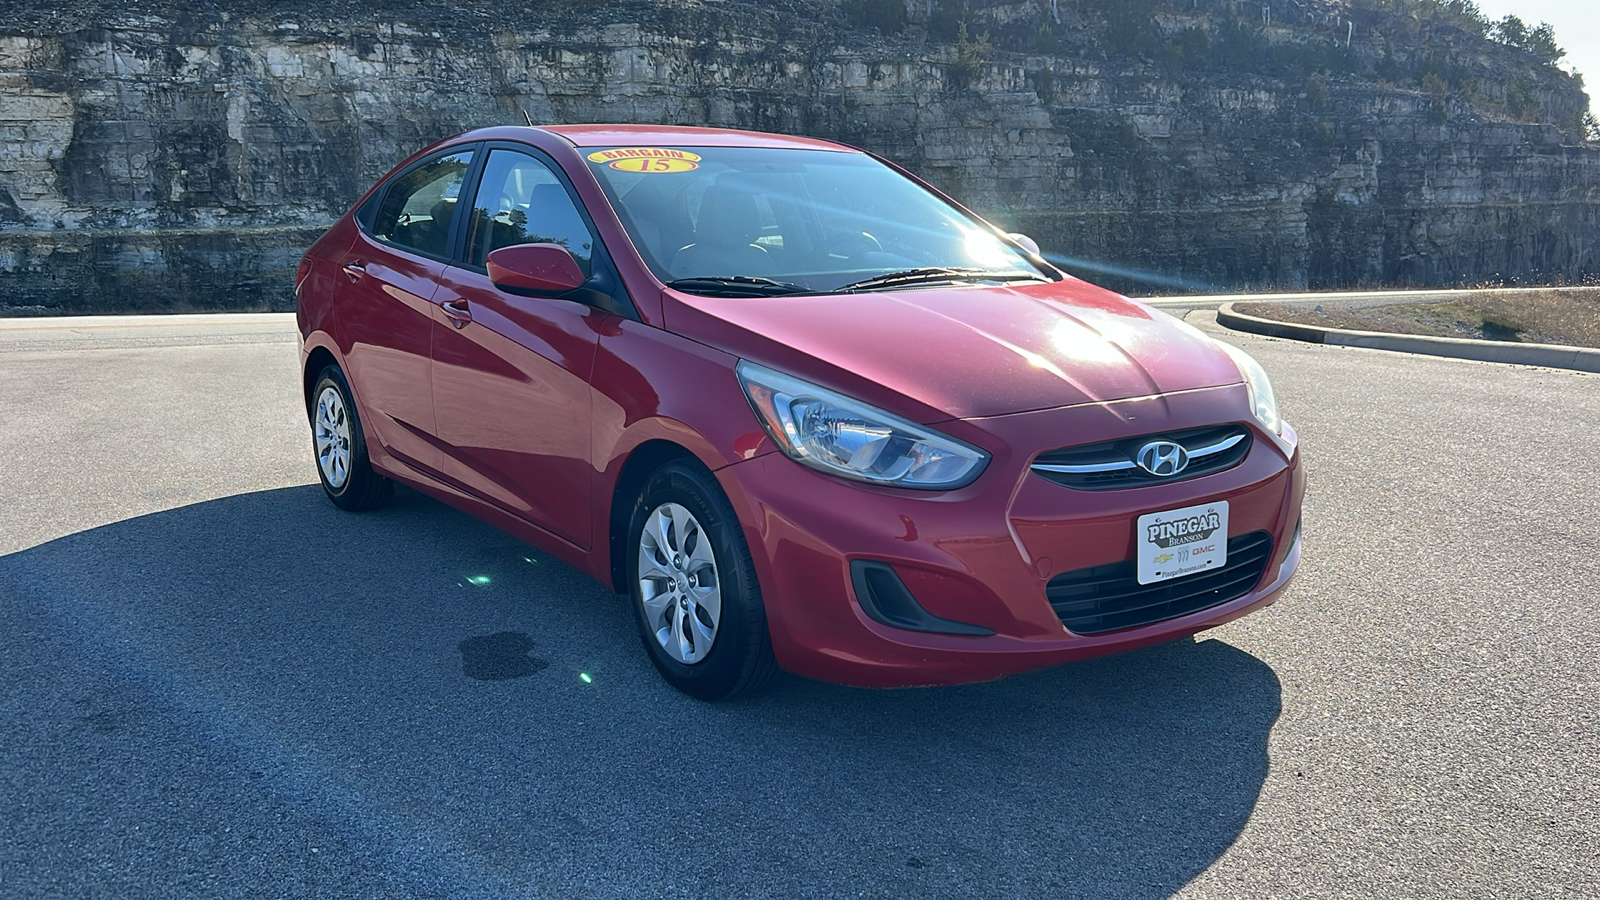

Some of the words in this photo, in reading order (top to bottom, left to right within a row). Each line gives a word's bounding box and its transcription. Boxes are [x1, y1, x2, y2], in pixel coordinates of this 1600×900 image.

[601, 149, 684, 159] BARGAIN
[641, 159, 670, 171] 15
[1148, 512, 1220, 542] PINEGAR
[1169, 533, 1204, 546] BRANSON
[1192, 544, 1215, 555] GMC
